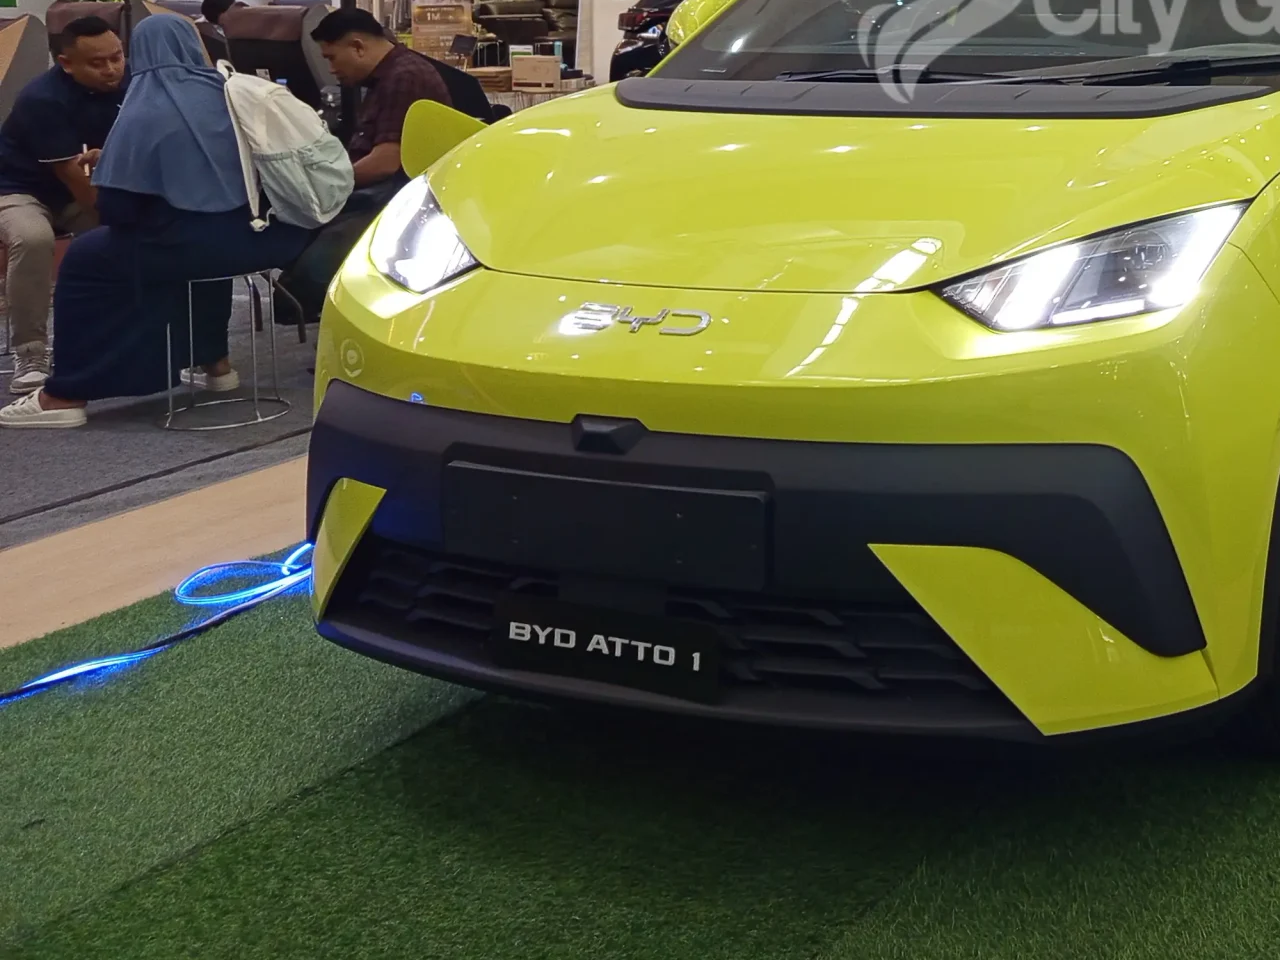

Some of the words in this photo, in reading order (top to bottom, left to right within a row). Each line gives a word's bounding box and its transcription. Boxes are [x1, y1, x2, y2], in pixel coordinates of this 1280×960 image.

[570, 301, 712, 337] BYD
[509, 622, 576, 649] BYD
[586, 634, 676, 667] ATTO
[692, 652, 700, 672] 1
